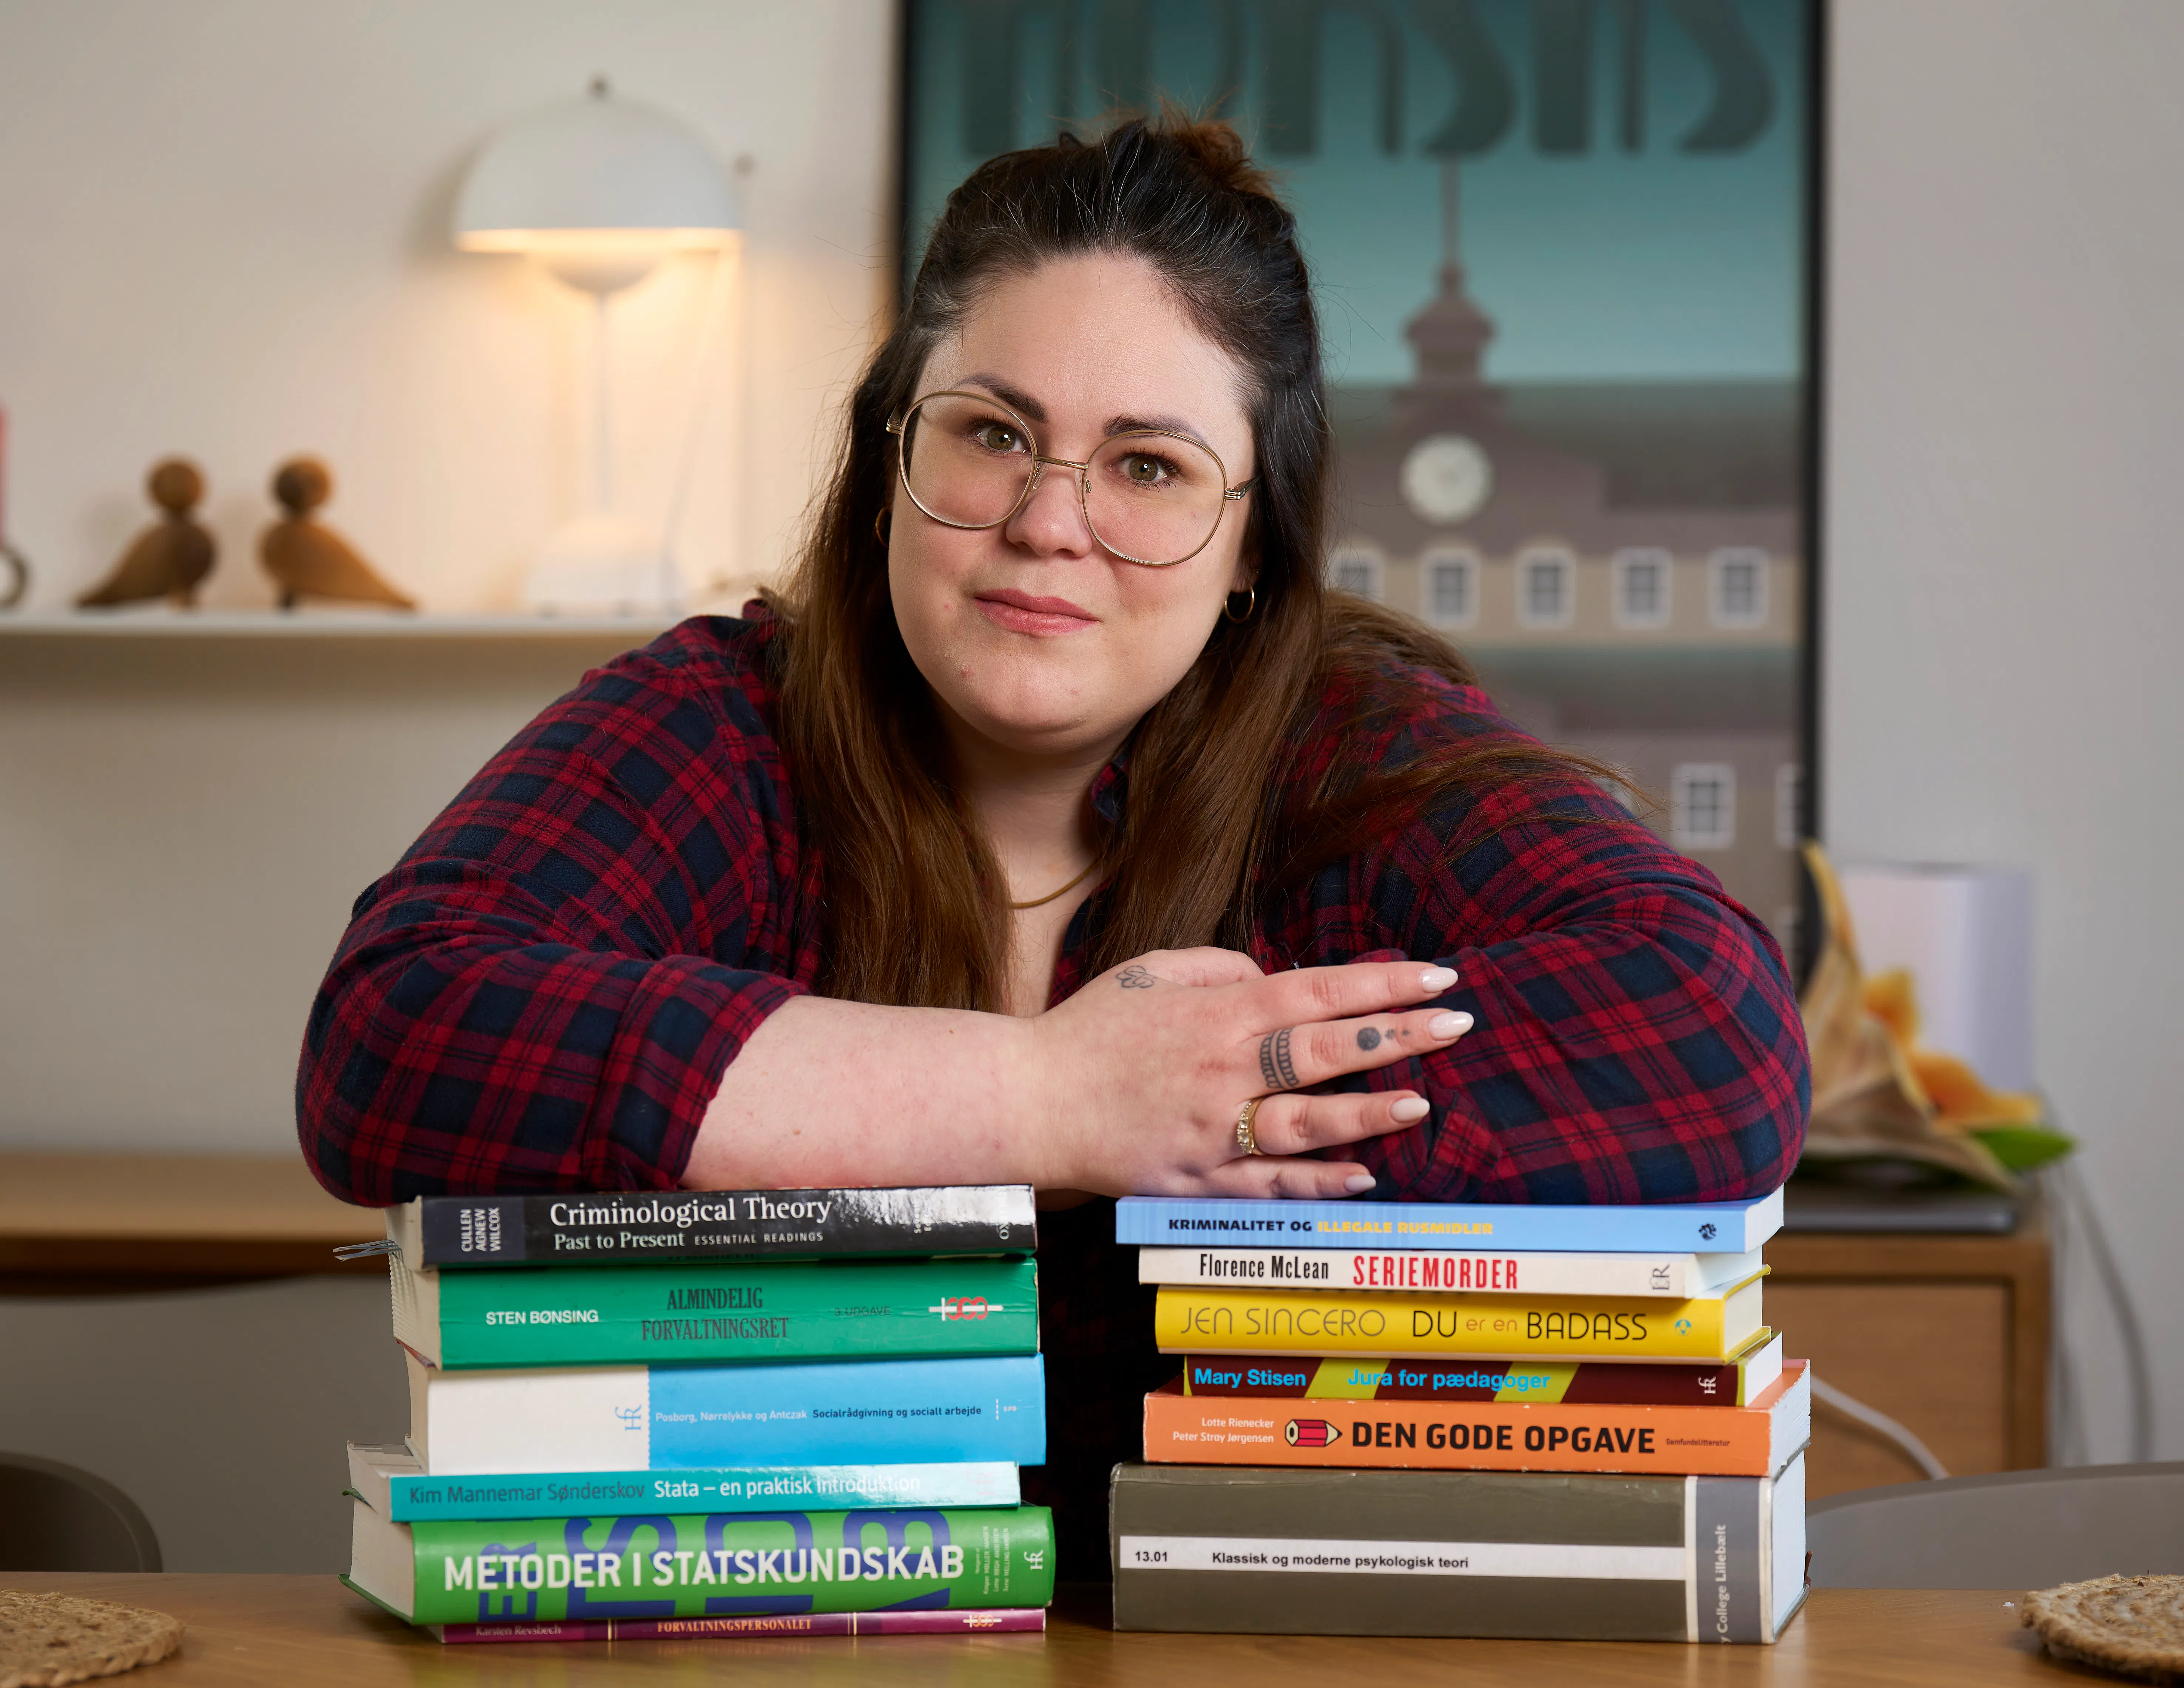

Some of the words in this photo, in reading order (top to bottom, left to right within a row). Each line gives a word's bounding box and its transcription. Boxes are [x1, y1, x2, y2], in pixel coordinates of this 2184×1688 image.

[550, 1198, 736, 1228] Criminological
[743, 1197, 832, 1224] Theory
[460, 1209, 473, 1252] CULLEN
[474, 1208, 487, 1252] AGNEW
[488, 1207, 501, 1252] WILCOX
[694, 1233, 757, 1245] ESSENTIAL
[764, 1231, 824, 1243] READINGS
[1169, 1220, 1285, 1232] KRIMINALITET
[1291, 1221, 1312, 1232] OG
[1318, 1222, 1392, 1233] ILLEGALE
[1398, 1222, 1494, 1235] RUSMIDLER
[554, 1233, 591, 1250] Past
[596, 1234, 614, 1249] to
[619, 1231, 686, 1248] Present
[1200, 1254, 1264, 1276] Florence
[1271, 1256, 1329, 1280] McLean
[1353, 1255, 1517, 1289] SERIEMORDER
[667, 1287, 763, 1310] ALMINDELIG
[486, 1311, 526, 1325] STEN
[530, 1309, 599, 1324] BØNSING
[834, 1308, 843, 1317] 3.
[845, 1305, 891, 1316] UDGAVE
[1181, 1308, 1233, 1334] JEN
[1246, 1308, 1385, 1336] SINCERO
[642, 1317, 788, 1341] FORVALTNINGSRET
[1413, 1310, 1457, 1337] DU
[1466, 1318, 1486, 1332] er
[1494, 1319, 1518, 1332] en
[1527, 1313, 1647, 1340] BADASS
[1194, 1369, 1242, 1388] Mary
[1247, 1369, 1306, 1386] Stisen
[1347, 1369, 1393, 1386] Jura
[1399, 1369, 1428, 1387] for
[1432, 1370, 1551, 1391] pædagoger
[700, 1411, 753, 1422] Nørrelykke
[755, 1412, 767, 1422] og
[769, 1410, 807, 1420] Antczak
[813, 1408, 893, 1419] Socialrådgivning
[896, 1410, 907, 1418] og
[910, 1407, 942, 1416] socialt
[945, 1406, 982, 1417] arbejde
[1202, 1417, 1227, 1427] Lotte
[1228, 1418, 1274, 1428] Rienecker
[1173, 1431, 1198, 1441] Peter
[1200, 1432, 1225, 1444] Stray
[1227, 1432, 1274, 1444] Jørgensen
[1352, 1422, 1416, 1448] DEN
[1426, 1424, 1513, 1451] GODE
[1525, 1425, 1656, 1454] OPGAVE
[1666, 1438, 1730, 1447] Samfundslitteratur
[410, 1487, 442, 1504] Kim
[448, 1484, 541, 1503] Mannemar
[547, 1481, 645, 1502] Sønderskov
[655, 1480, 699, 1498] Stata
[720, 1482, 741, 1496] en
[746, 1475, 813, 1499] praktisk
[1135, 1552, 1168, 1562] 13.01
[1213, 1553, 1268, 1564] Klassisk
[1272, 1556, 1288, 1566] og
[1293, 1555, 1350, 1566] moderne
[1355, 1555, 1434, 1569] psykologisk
[1438, 1557, 1468, 1568] teori
[1715, 1523, 1727, 1582] Lillebælt
[444, 1553, 621, 1591] METODER
[633, 1553, 641, 1586] I
[653, 1546, 964, 1586] STATSKUNDSKAB
[1716, 1585, 1730, 1634] College
[476, 1627, 512, 1636] Karsten
[514, 1624, 561, 1635] Revsbech
[657, 1619, 811, 1633] FORVALTNINGSPERSONALET
